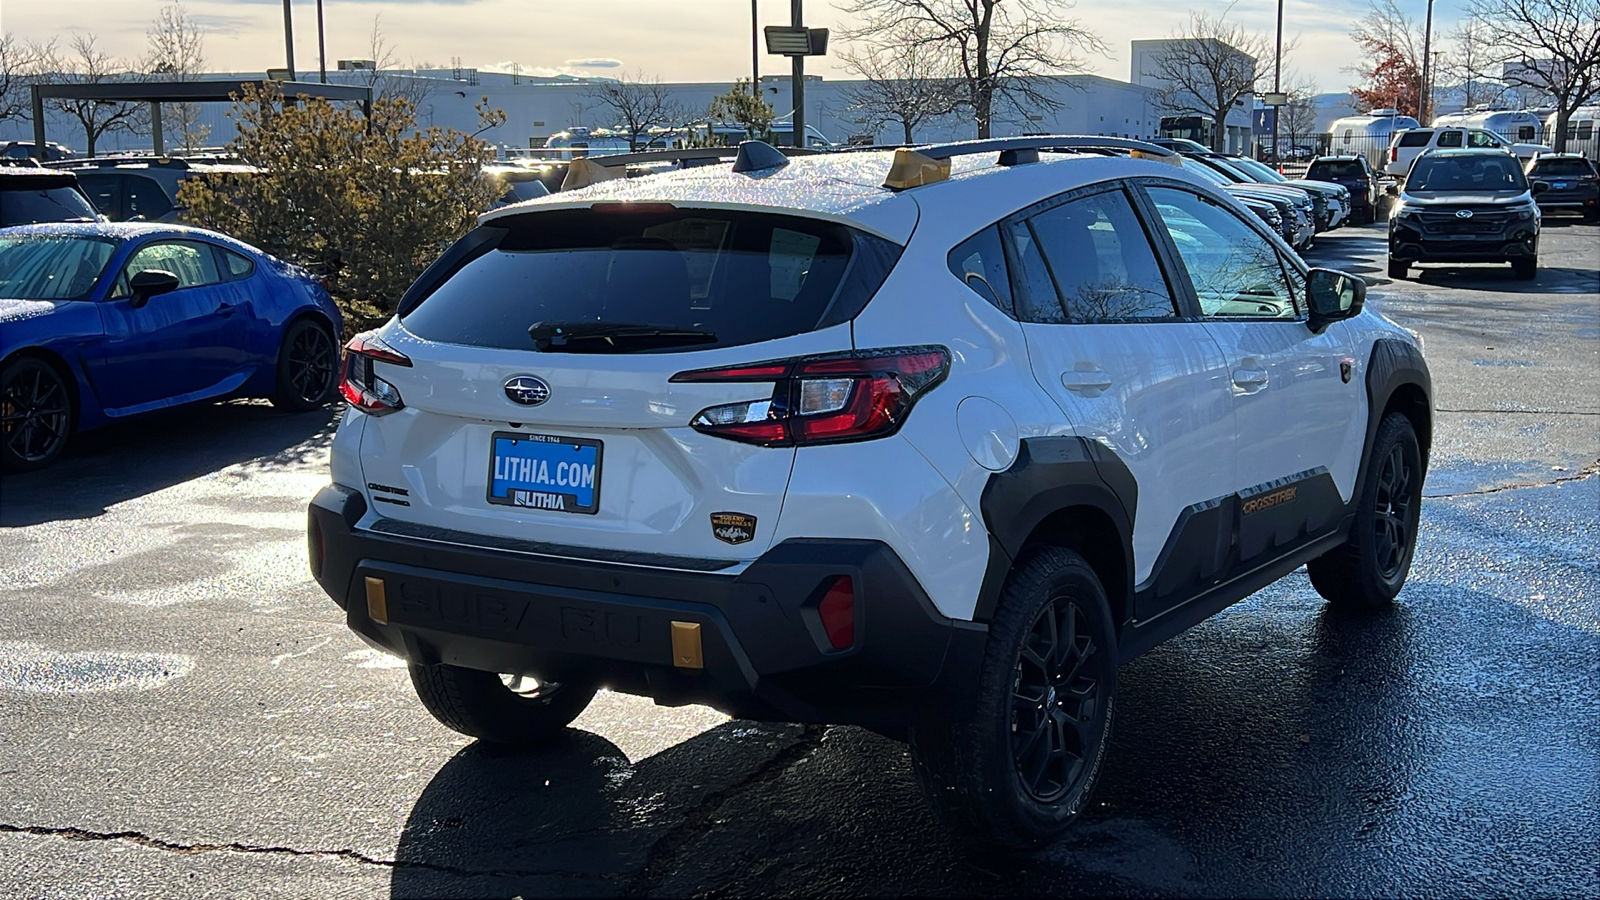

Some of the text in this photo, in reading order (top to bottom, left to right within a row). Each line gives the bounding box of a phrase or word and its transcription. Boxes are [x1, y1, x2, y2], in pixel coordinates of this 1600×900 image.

[529, 434, 560, 443] SINCE 1946
[494, 455, 596, 489] LITHIA.COM
[525, 491, 565, 510] LITHIA
[1243, 487, 1297, 514] CROSSTREK
[713, 519, 752, 527] WILDERNESS
